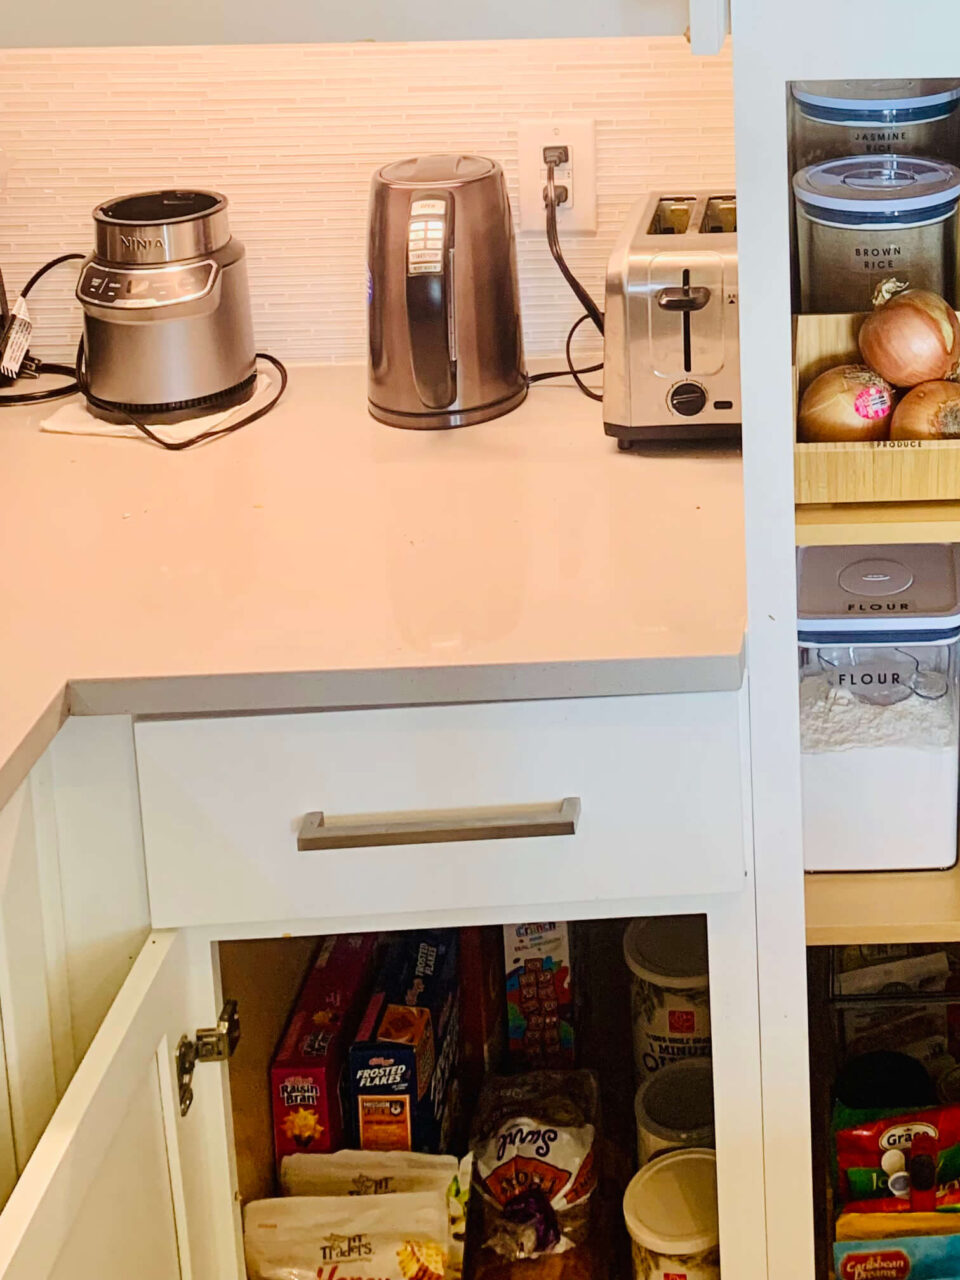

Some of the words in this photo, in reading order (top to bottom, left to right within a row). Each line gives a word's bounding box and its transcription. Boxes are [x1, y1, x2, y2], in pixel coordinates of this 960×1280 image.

[855, 131, 906, 141] JASMINE
[866, 144, 892, 153] RICE
[855, 247, 901, 257] BROWN
[864, 260, 894, 270] RICE
[876, 440, 922, 448] PRODUCE
[847, 602, 910, 613] FLOUR
[838, 672, 902, 687] FLOUR
[356, 1065, 406, 1079] FROSTED
[359, 1075, 401, 1087] FLAKES
[280, 1084, 320, 1098] Raisin
[285, 1094, 317, 1106] Bran
[320, 1242, 373, 1260] Traders
[846, 1255, 905, 1273] Caribbean
